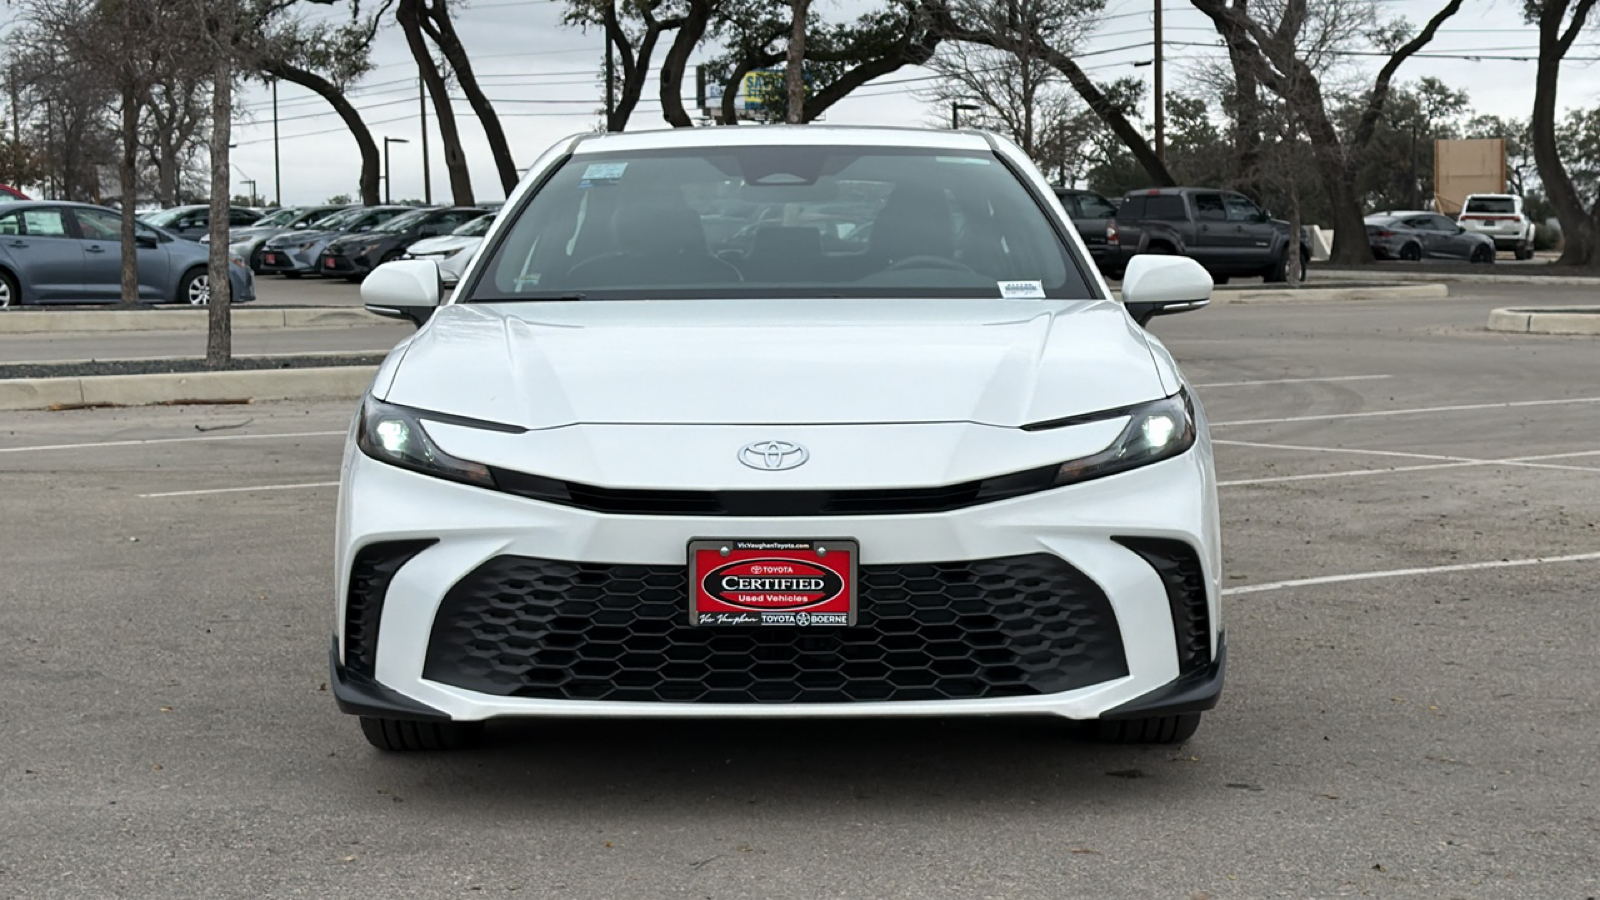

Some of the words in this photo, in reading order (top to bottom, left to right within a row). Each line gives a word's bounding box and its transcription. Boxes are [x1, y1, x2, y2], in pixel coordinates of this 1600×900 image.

[737, 542, 810, 550] VicVaughanToyota.com
[721, 576, 825, 590] CERTIFIED
[738, 594, 764, 602] Used
[766, 594, 808, 602] Vehicles
[699, 613, 715, 624] Vic
[717, 612, 759, 625] Vaughan
[761, 615, 796, 623] TOYOTA
[811, 615, 847, 623] BOERNE
